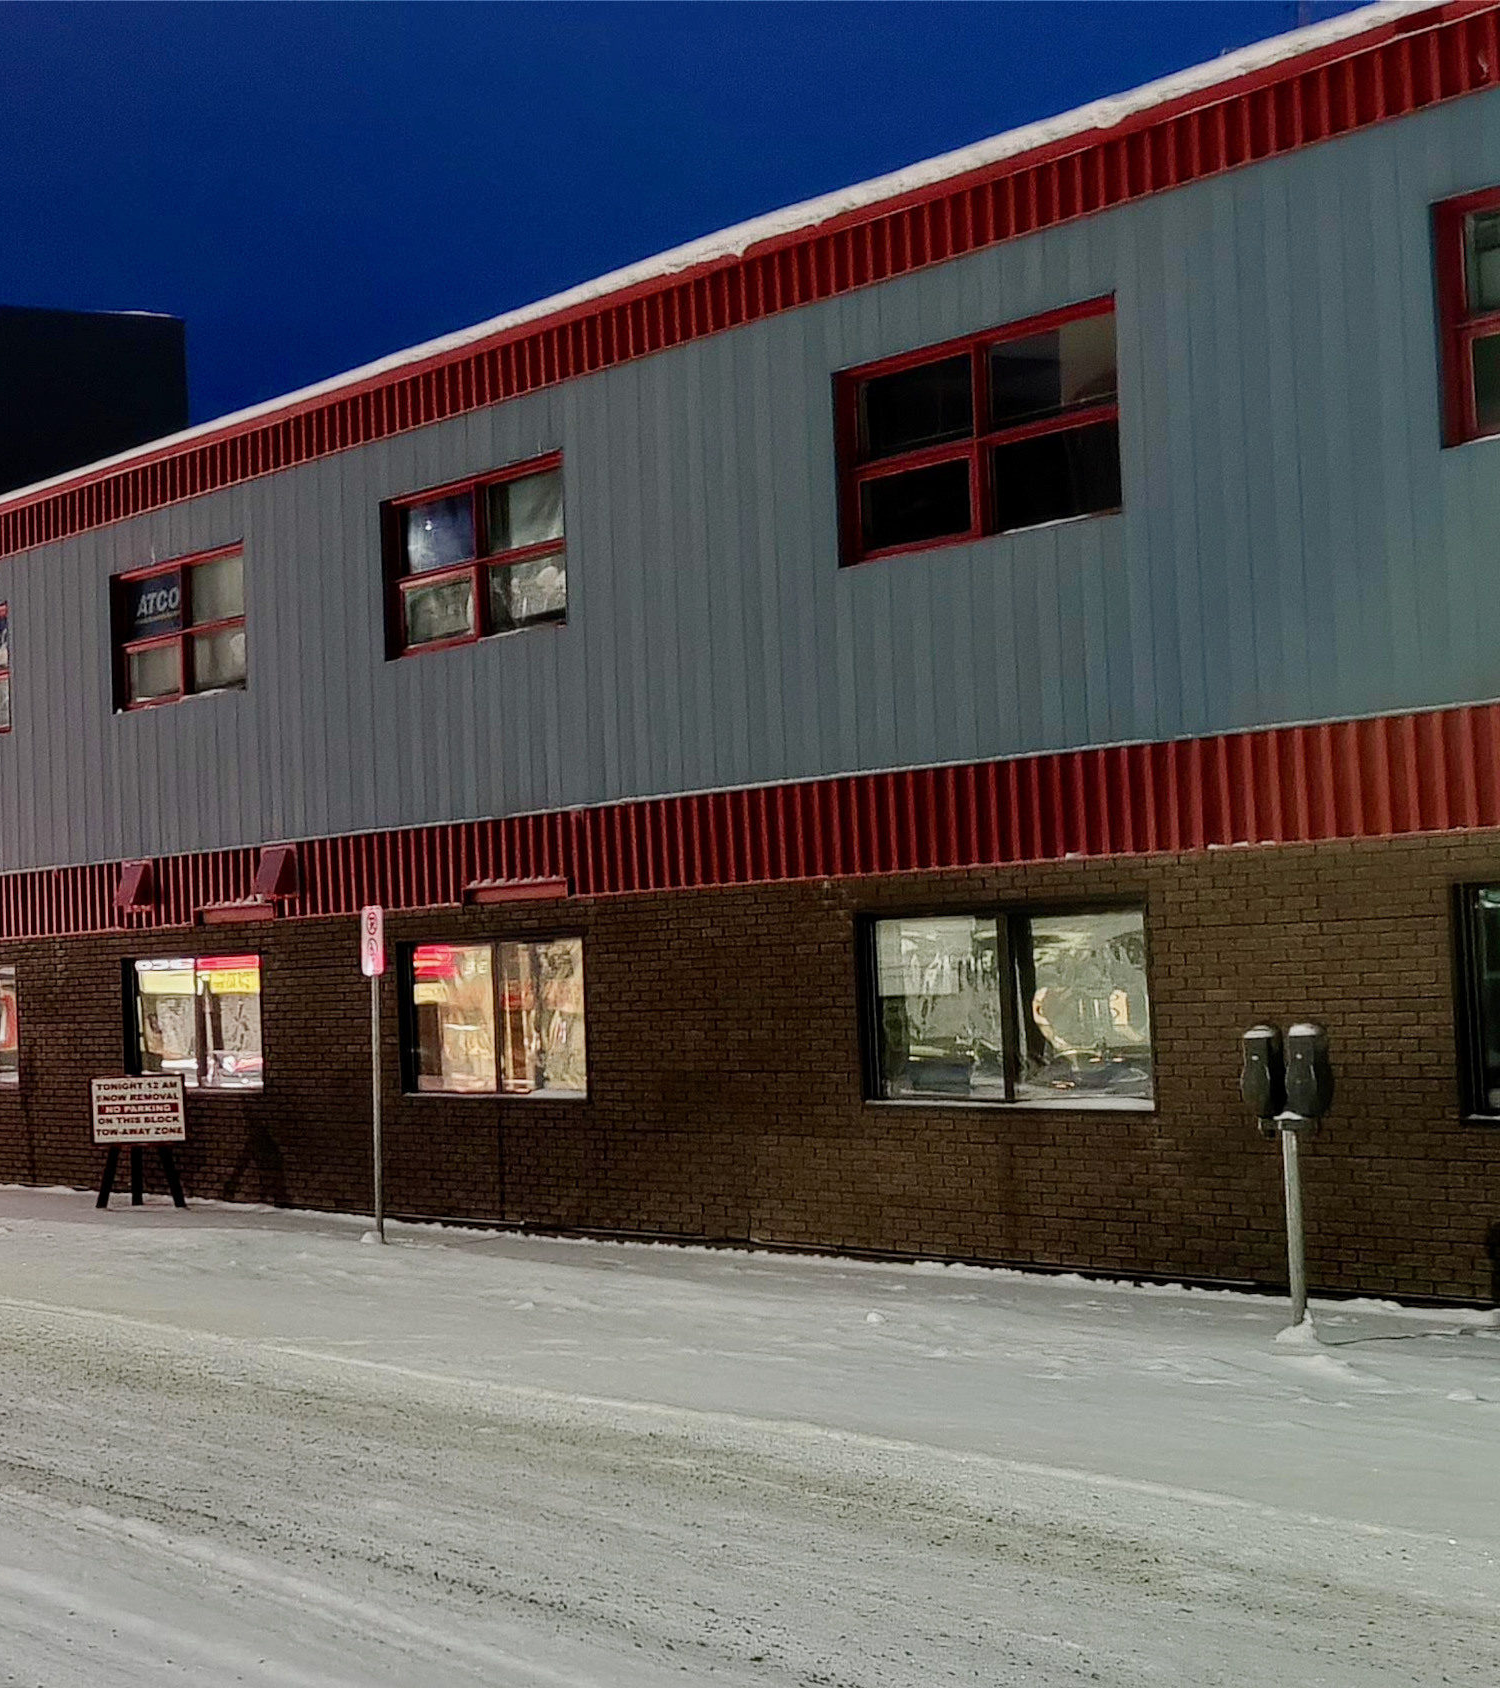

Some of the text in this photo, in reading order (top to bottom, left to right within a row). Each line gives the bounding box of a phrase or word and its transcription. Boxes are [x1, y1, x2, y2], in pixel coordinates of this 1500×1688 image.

[136, 586, 179, 617] ATCO
[96, 1081, 177, 1091] TONIGHT 12 AM
[130, 1093, 179, 1101] REMOVAL
[124, 1104, 172, 1113] PARKING
[96, 1127, 183, 1136] TOW-AWAY ZONE
